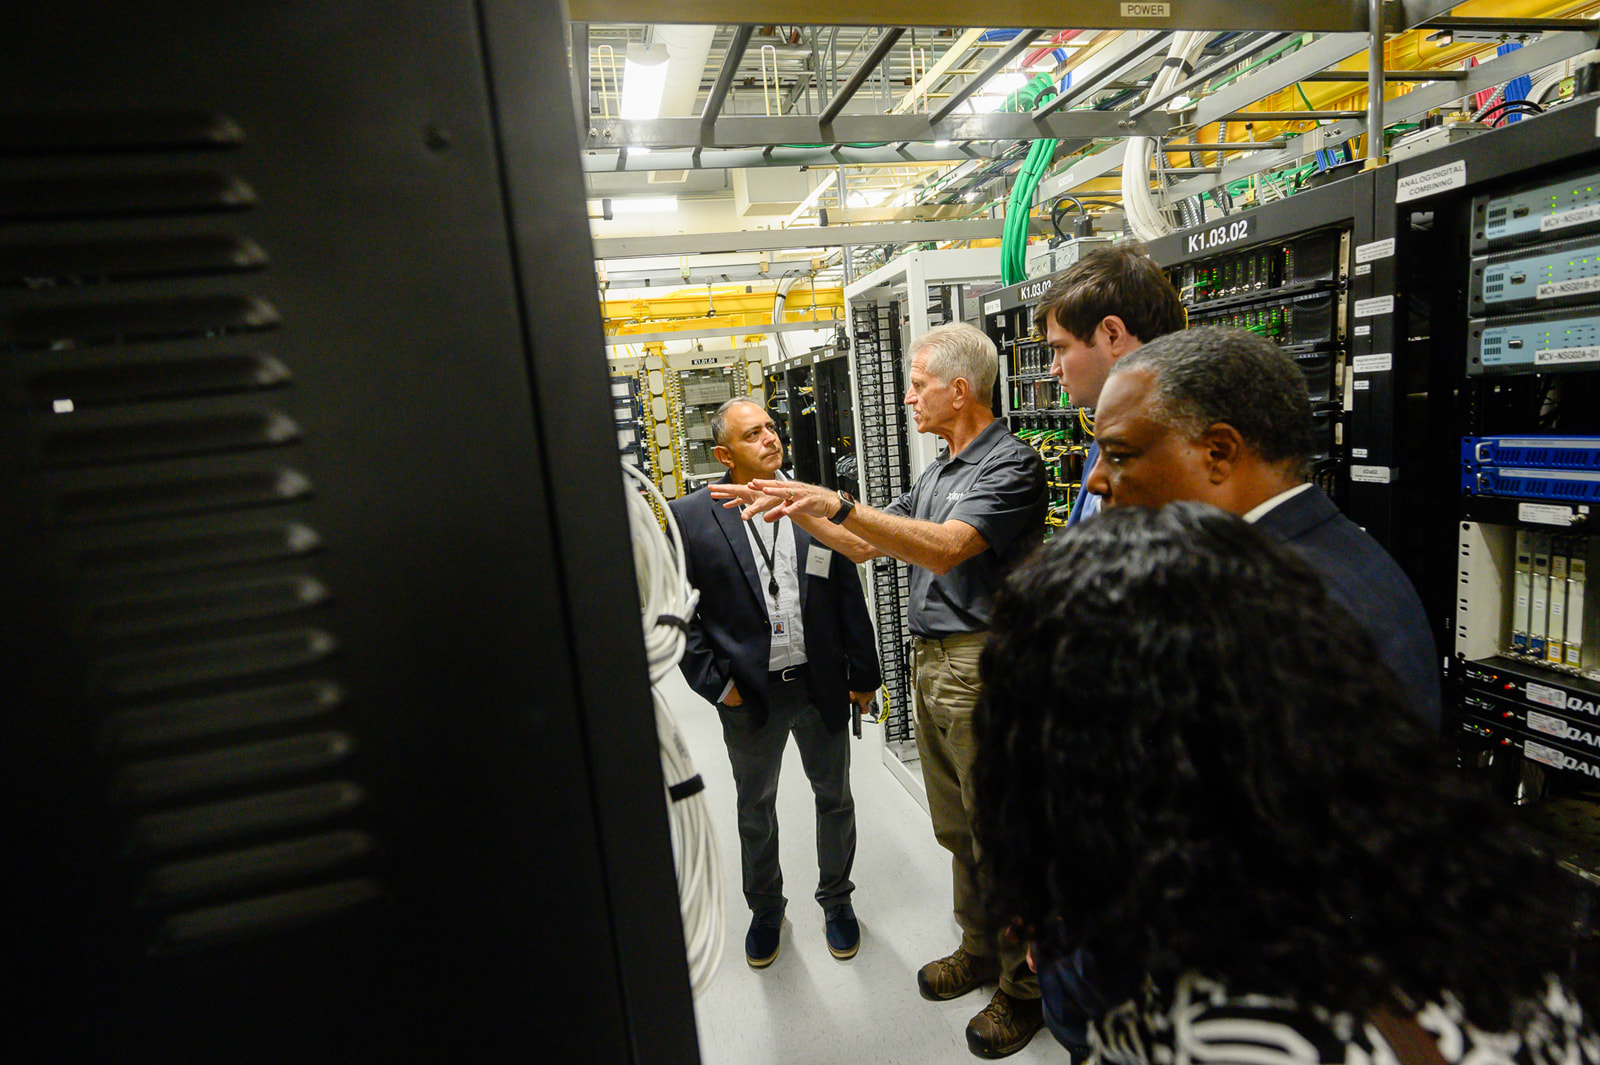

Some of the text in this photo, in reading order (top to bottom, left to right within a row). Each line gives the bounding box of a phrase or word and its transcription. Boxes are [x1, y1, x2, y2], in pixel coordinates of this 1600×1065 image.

[1127, 5, 1164, 15] POWER
[1400, 165, 1464, 188] ANALOG/DIGITAL
[1409, 178, 1453, 196] COMBINING
[1188, 220, 1248, 253] K1.03.02
